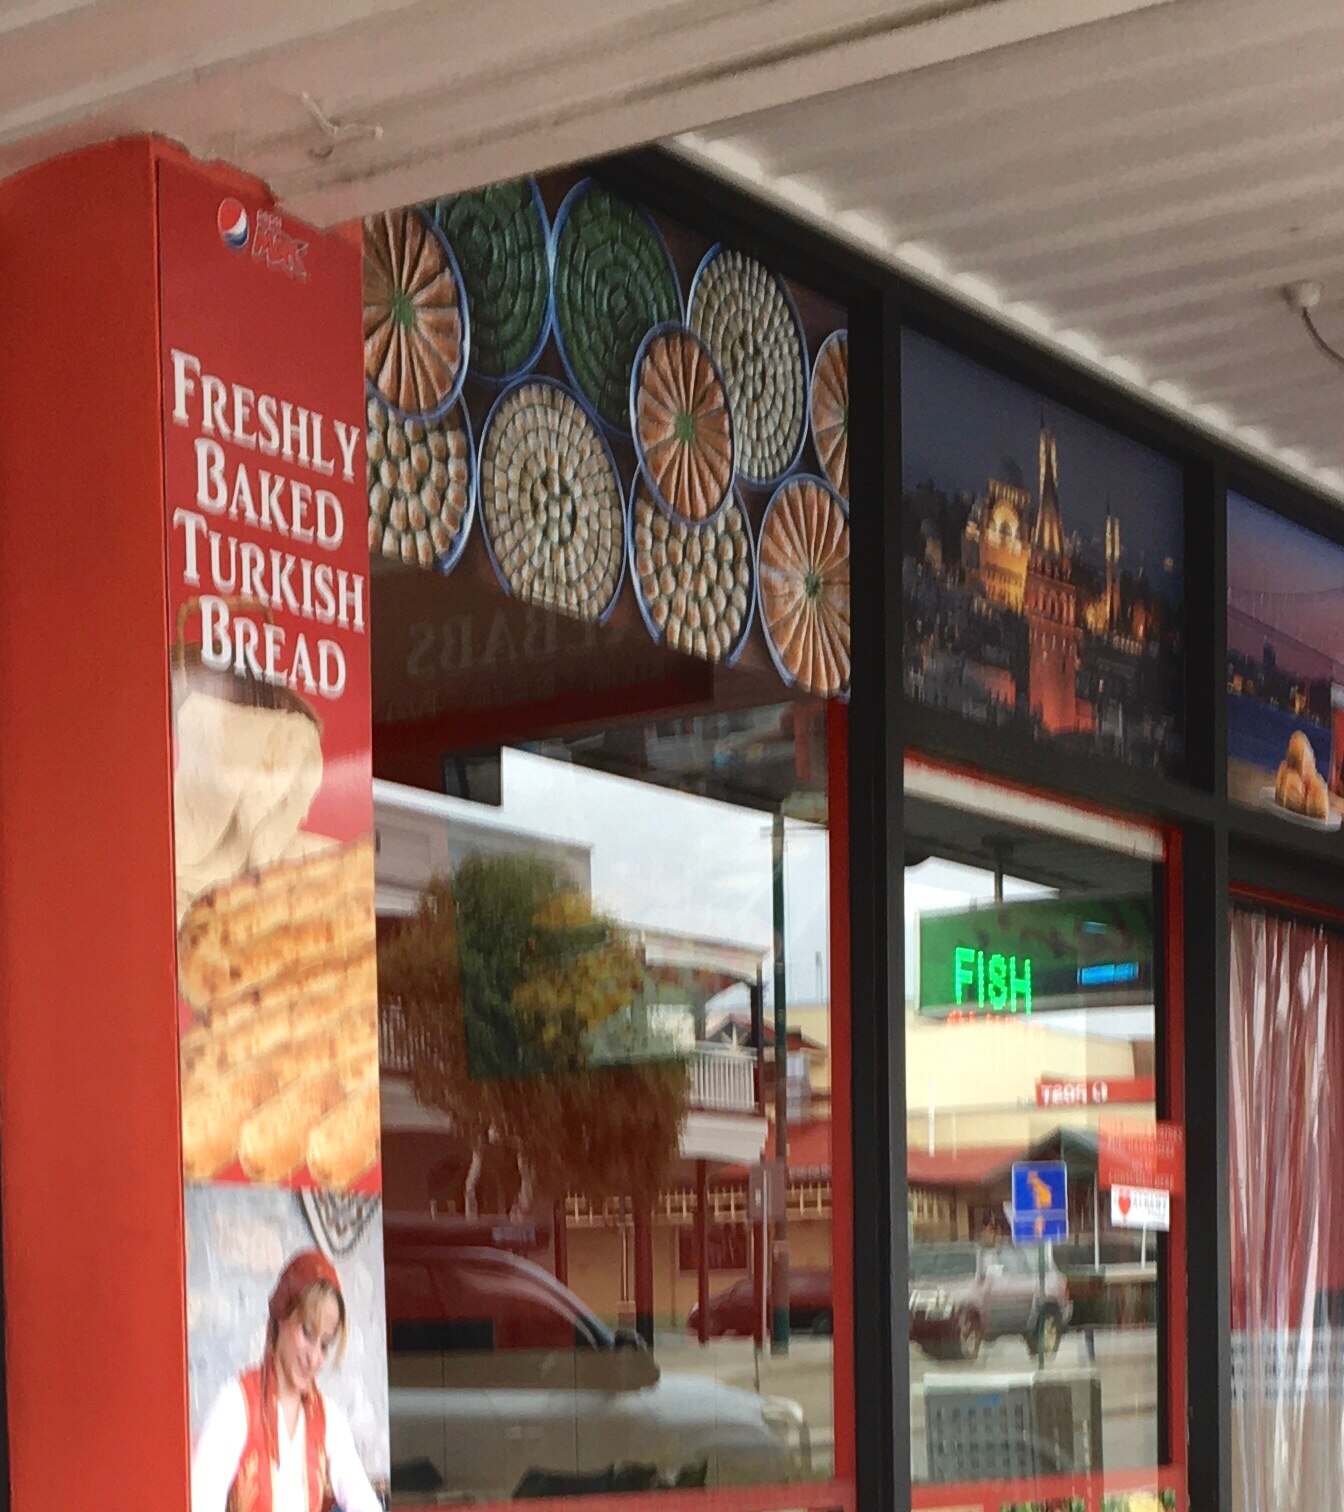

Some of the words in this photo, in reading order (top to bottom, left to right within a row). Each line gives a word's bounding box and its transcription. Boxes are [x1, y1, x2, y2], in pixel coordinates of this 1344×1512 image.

[170, 348, 360, 483] FRESHLY
[194, 437, 344, 550] BAKED
[173, 507, 365, 634] TURKISH
[199, 594, 346, 699] BREAD
[955, 946, 1032, 1015] FISH
